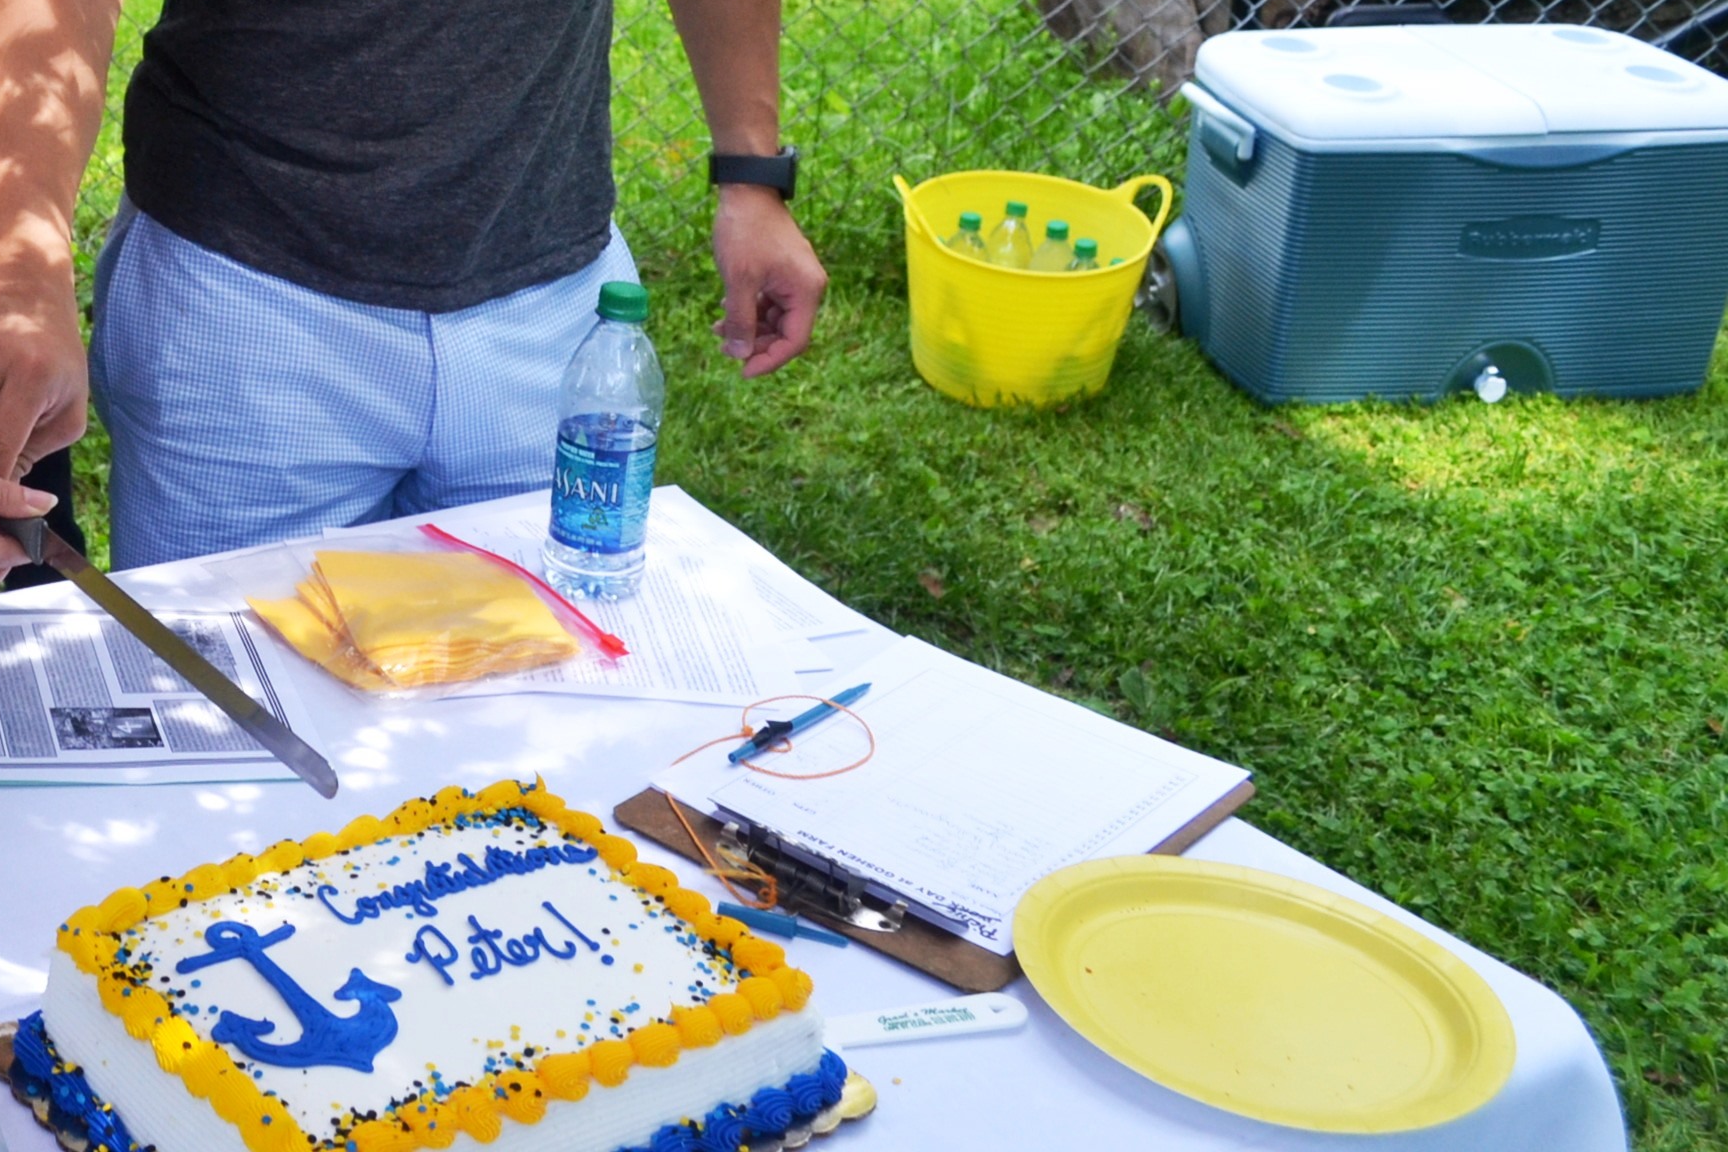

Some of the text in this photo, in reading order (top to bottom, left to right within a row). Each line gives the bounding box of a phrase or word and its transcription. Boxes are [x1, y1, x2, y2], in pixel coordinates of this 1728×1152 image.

[556, 467, 619, 504] SANI
[797, 830, 836, 850] FARM
[837, 849, 895, 879] GOSHEN
[915, 886, 946, 902] DAY
[405, 901, 614, 986] Peter!
